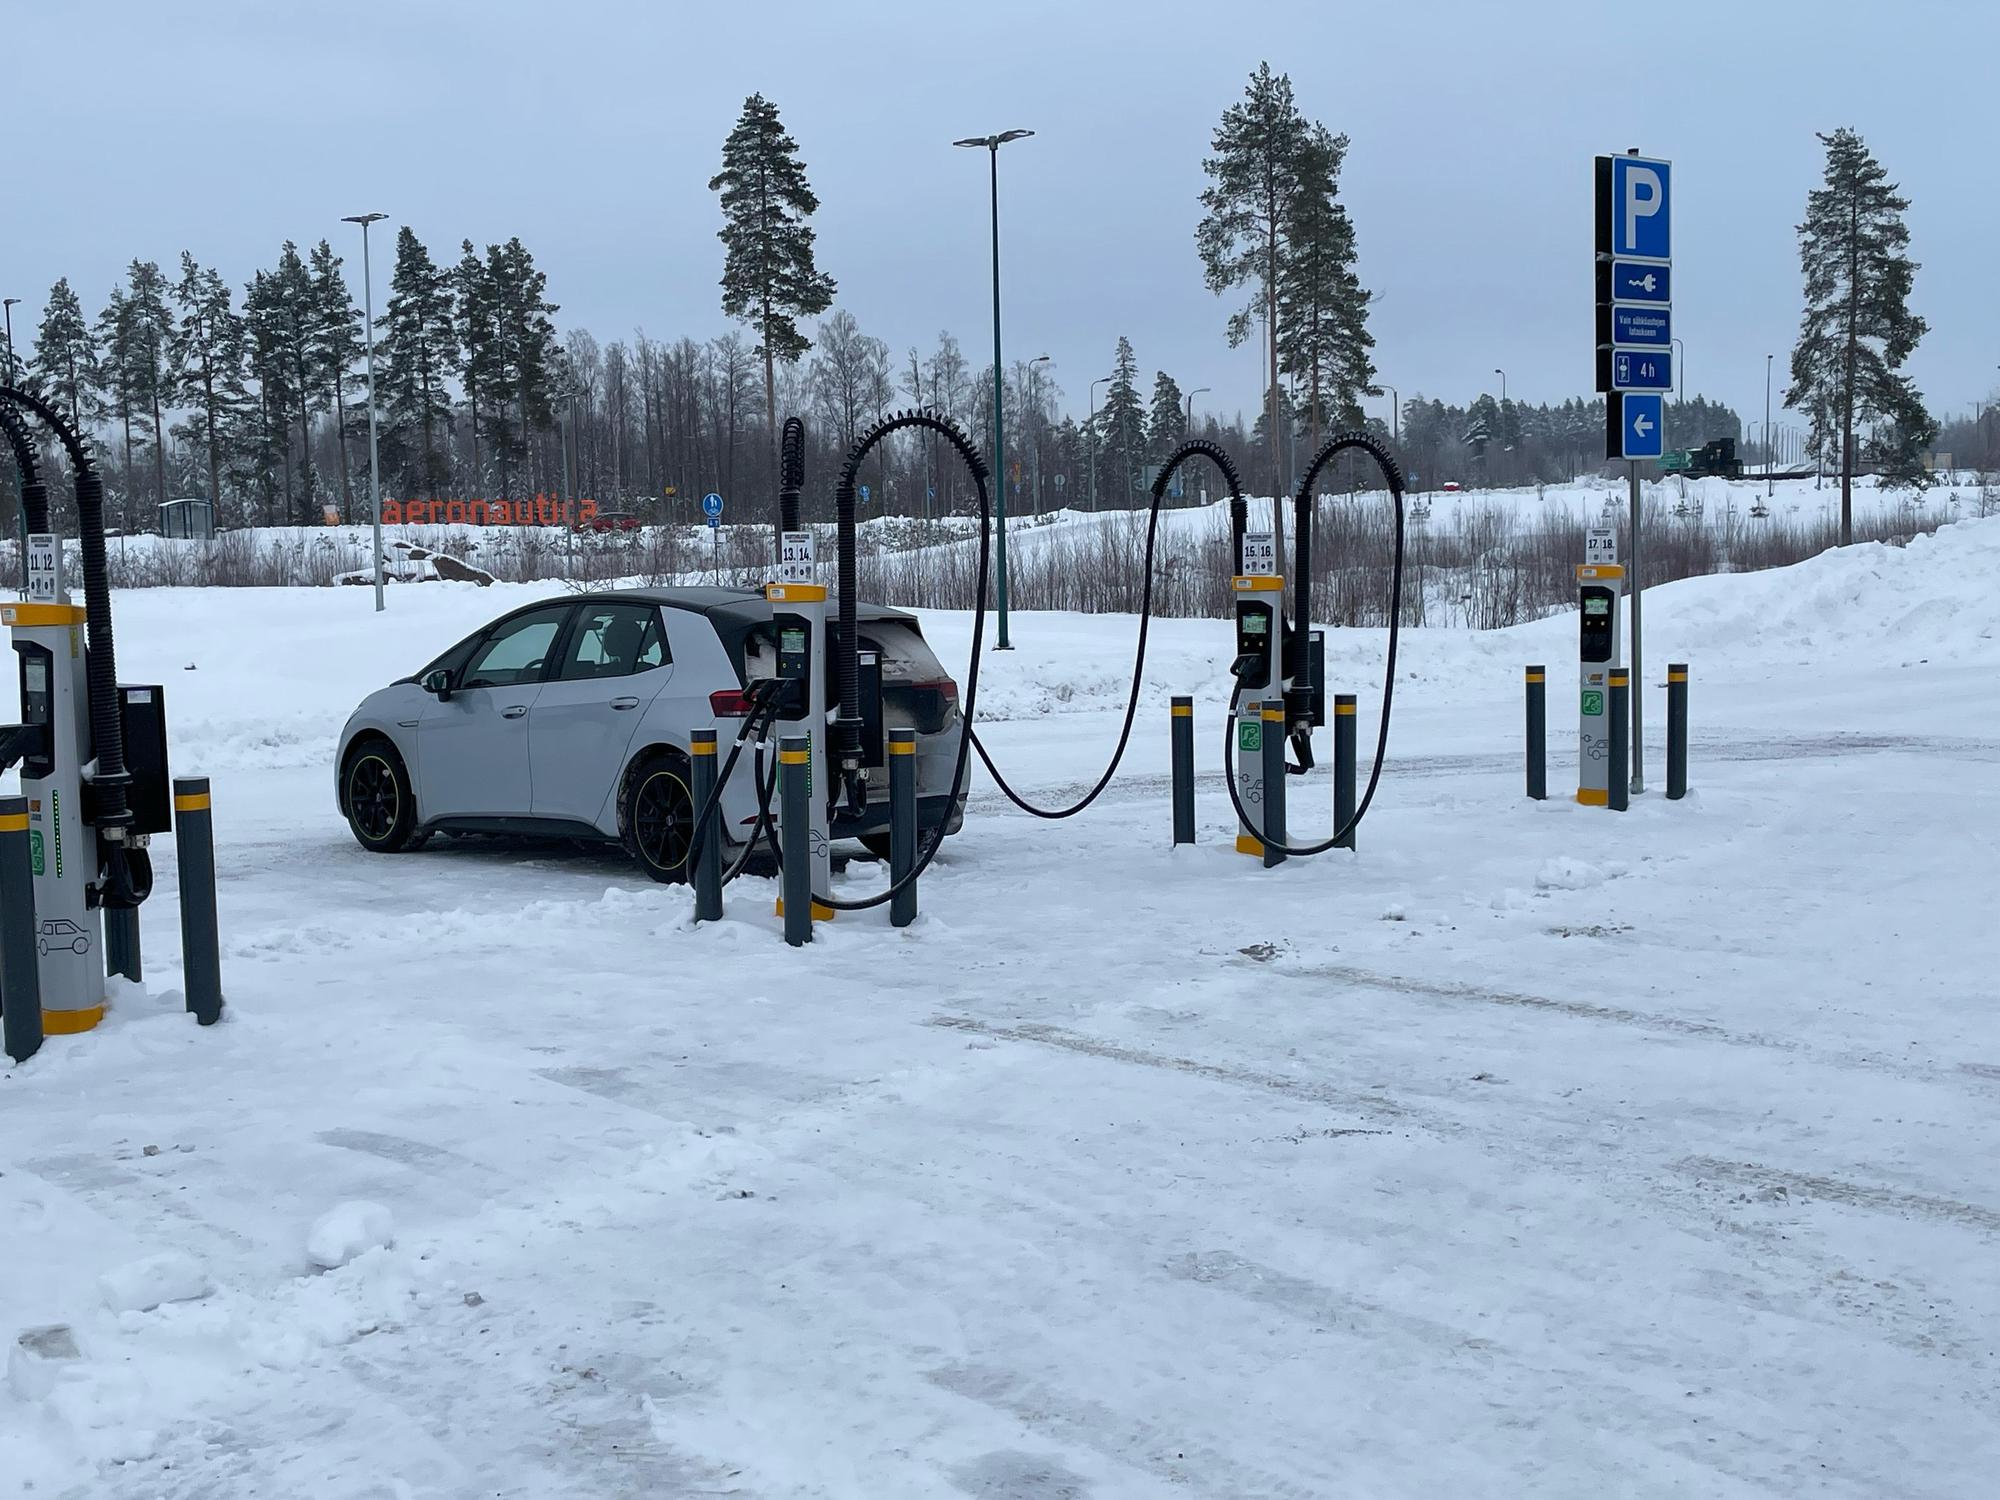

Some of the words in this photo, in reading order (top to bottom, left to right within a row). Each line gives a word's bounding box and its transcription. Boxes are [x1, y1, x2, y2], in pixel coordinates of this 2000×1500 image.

[1626, 165, 1662, 249] P
[1640, 362, 1647, 378] 4
[1648, 362, 1655, 378] h
